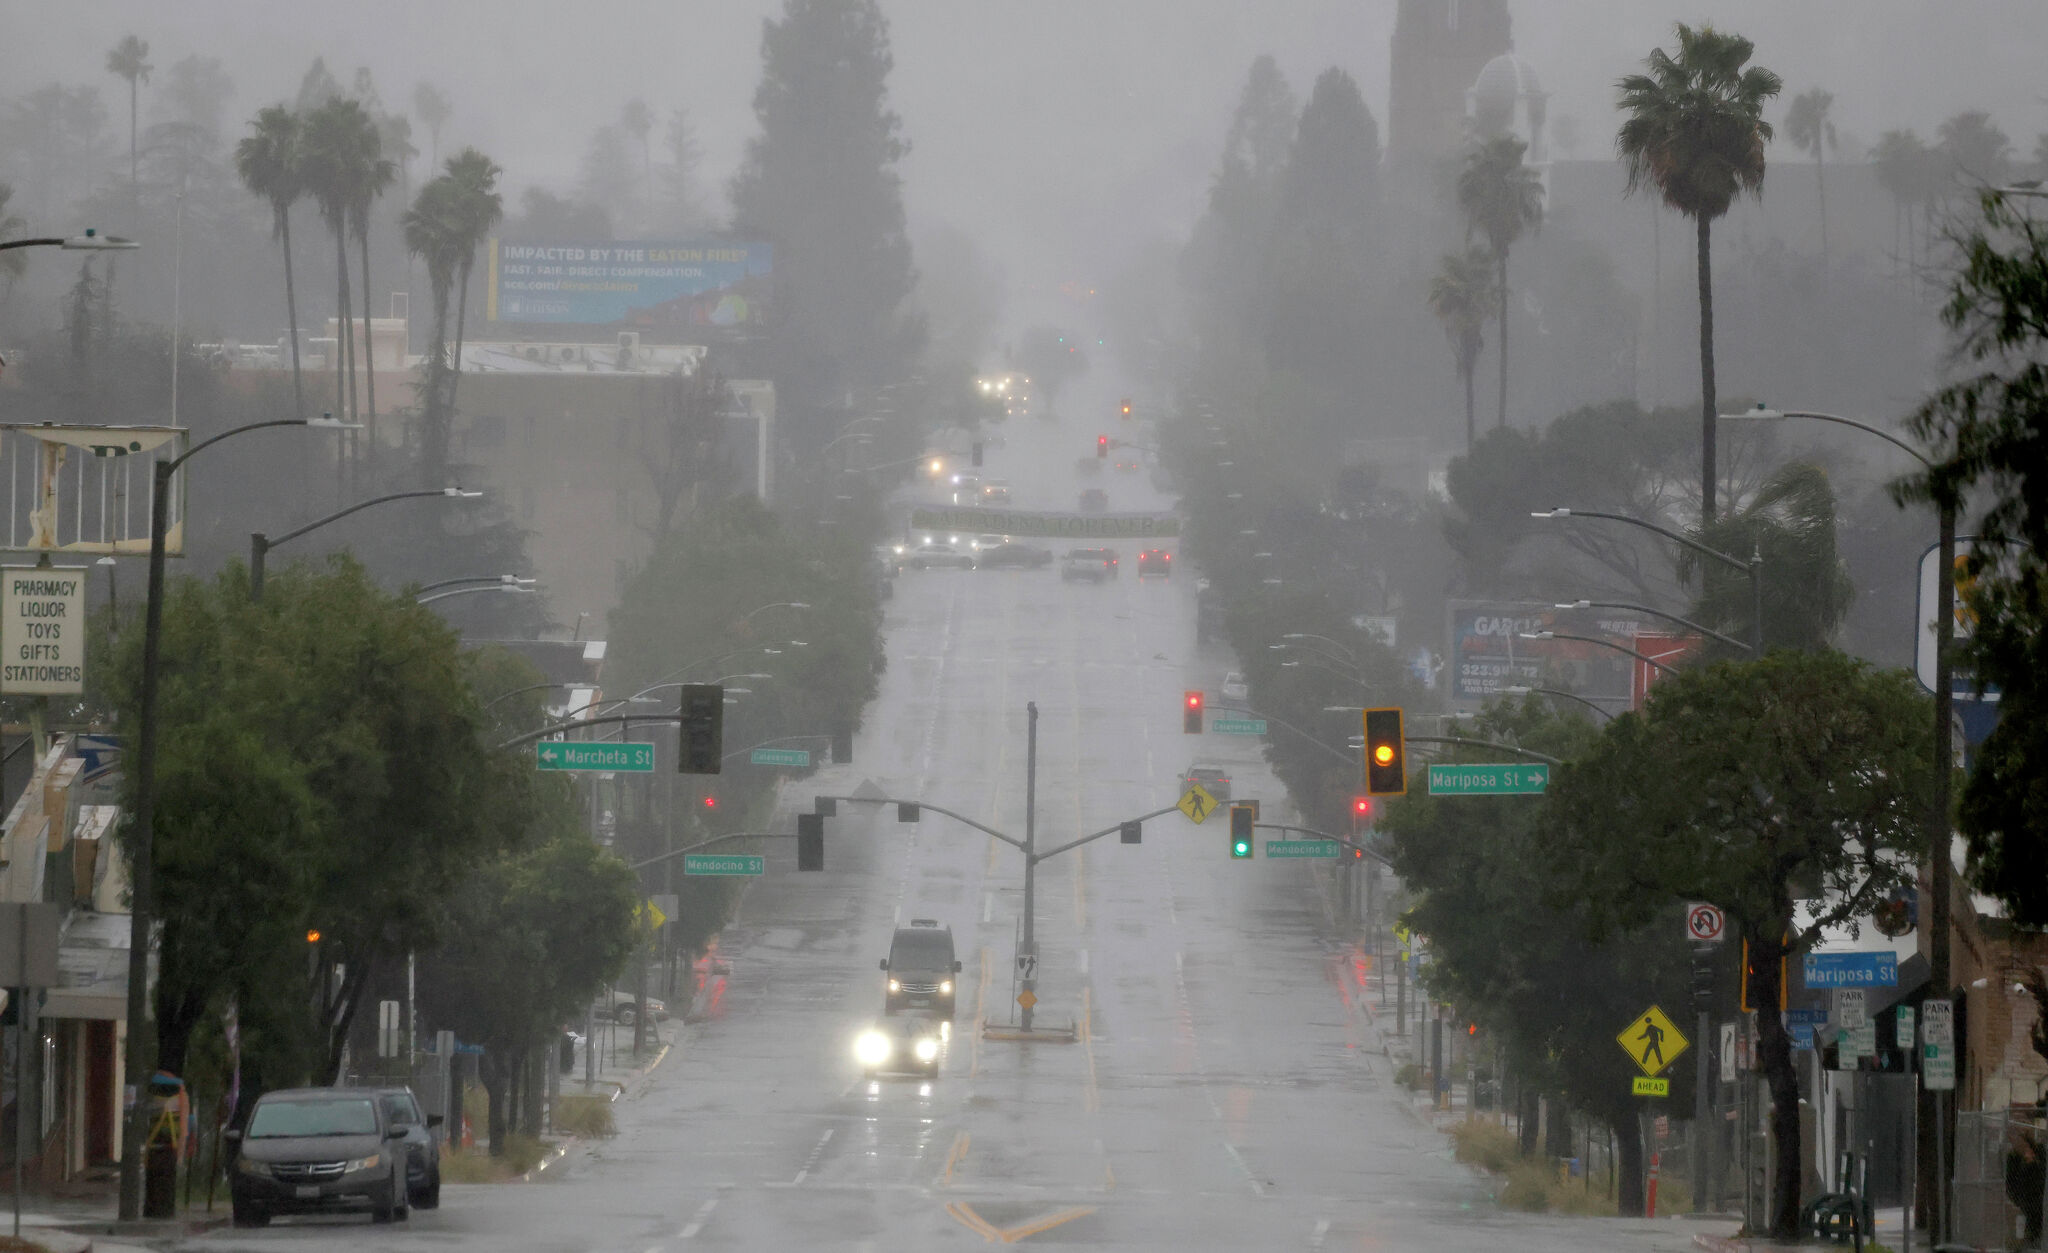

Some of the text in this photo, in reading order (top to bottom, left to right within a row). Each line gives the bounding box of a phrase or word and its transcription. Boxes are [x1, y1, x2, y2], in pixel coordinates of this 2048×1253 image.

[505, 246, 585, 261] IMPACTED
[590, 248, 610, 261] BY
[614, 249, 644, 262] THE
[649, 249, 702, 262] EATON
[569, 266, 608, 277] DIRECT
[14, 580, 77, 596] PHARMACY
[21, 601, 66, 617] LIQUOR
[26, 623, 61, 639] TOYS
[20, 645, 60, 660] GIFTS
[4, 666, 81, 682] STATIONERS
[565, 749, 650, 766] Marcheta St
[1433, 772, 1519, 790] Mariposa St
[1268, 844, 1337, 855] Mendocino St
[688, 860, 761, 871] Mendocino St
[1806, 966, 1895, 985] Mariposa St
[1840, 992, 1863, 1001] PARK
[1924, 1003, 1950, 1014] PARK
[1637, 1081, 1665, 1092] AHEAD
